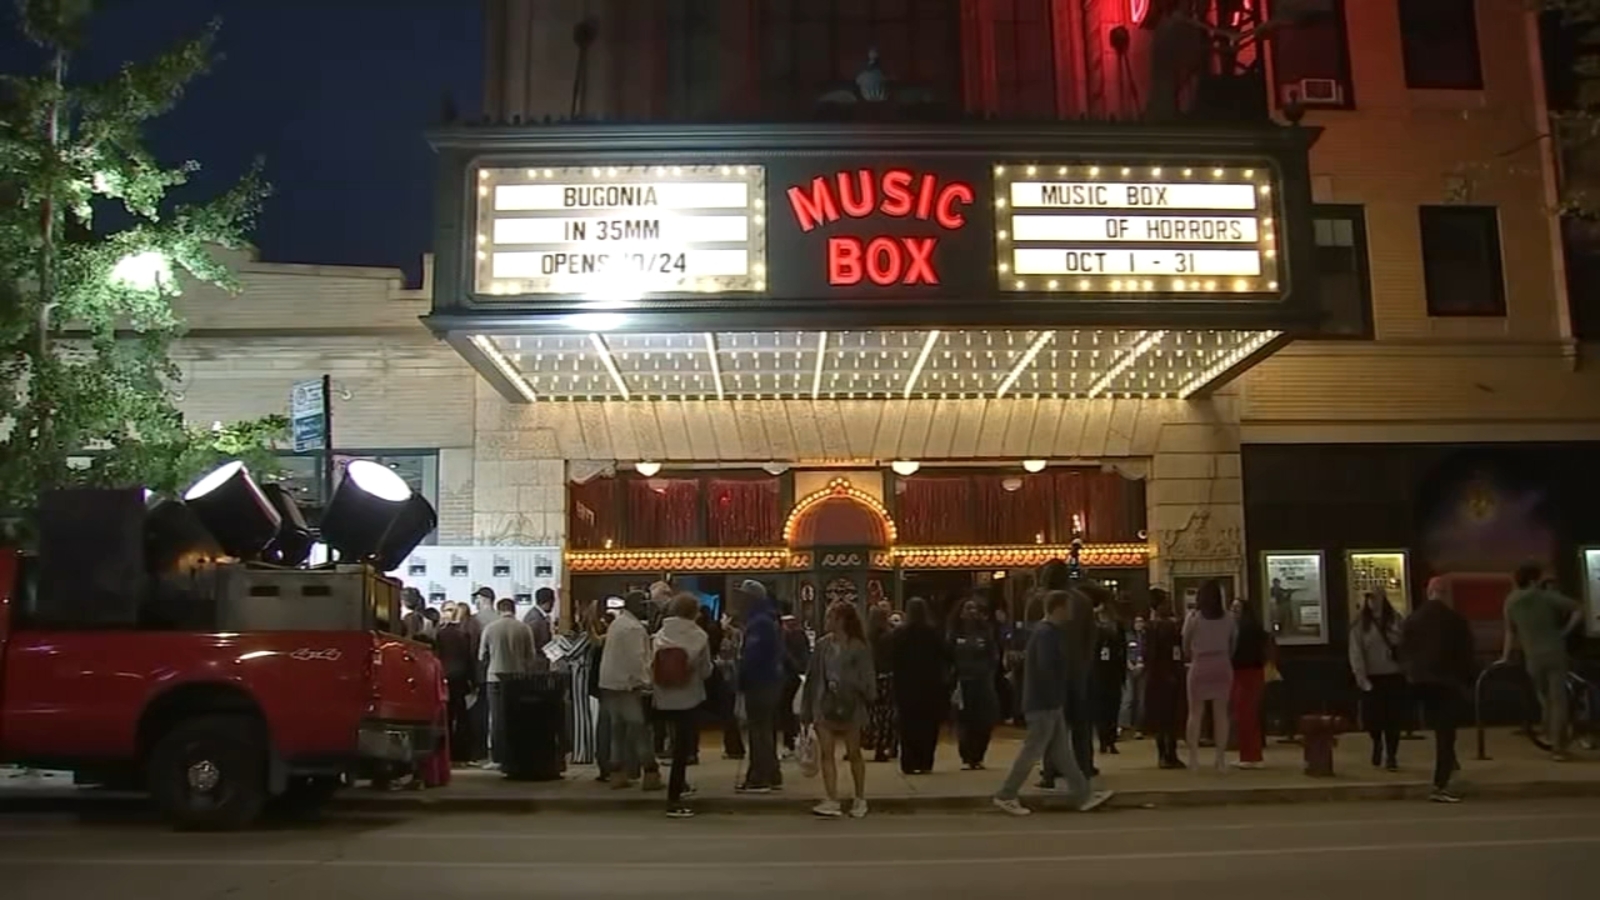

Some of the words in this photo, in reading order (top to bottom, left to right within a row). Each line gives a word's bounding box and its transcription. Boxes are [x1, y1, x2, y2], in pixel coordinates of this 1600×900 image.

[563, 186, 658, 207] BUGONIA
[787, 170, 973, 232] MUSIC
[1041, 185, 1108, 206] MUSIC
[1126, 186, 1168, 206] BOX
[564, 221, 586, 241] IN
[596, 220, 660, 241] 35MM
[1105, 218, 1129, 239] OF
[1146, 219, 1242, 240] HORRORS
[624, 252, 687, 274] 0/24
[828, 237, 939, 285] BOX
[1065, 252, 1106, 273] OCT
[1129, 252, 1135, 273] 1
[1174, 252, 1195, 273] 31
